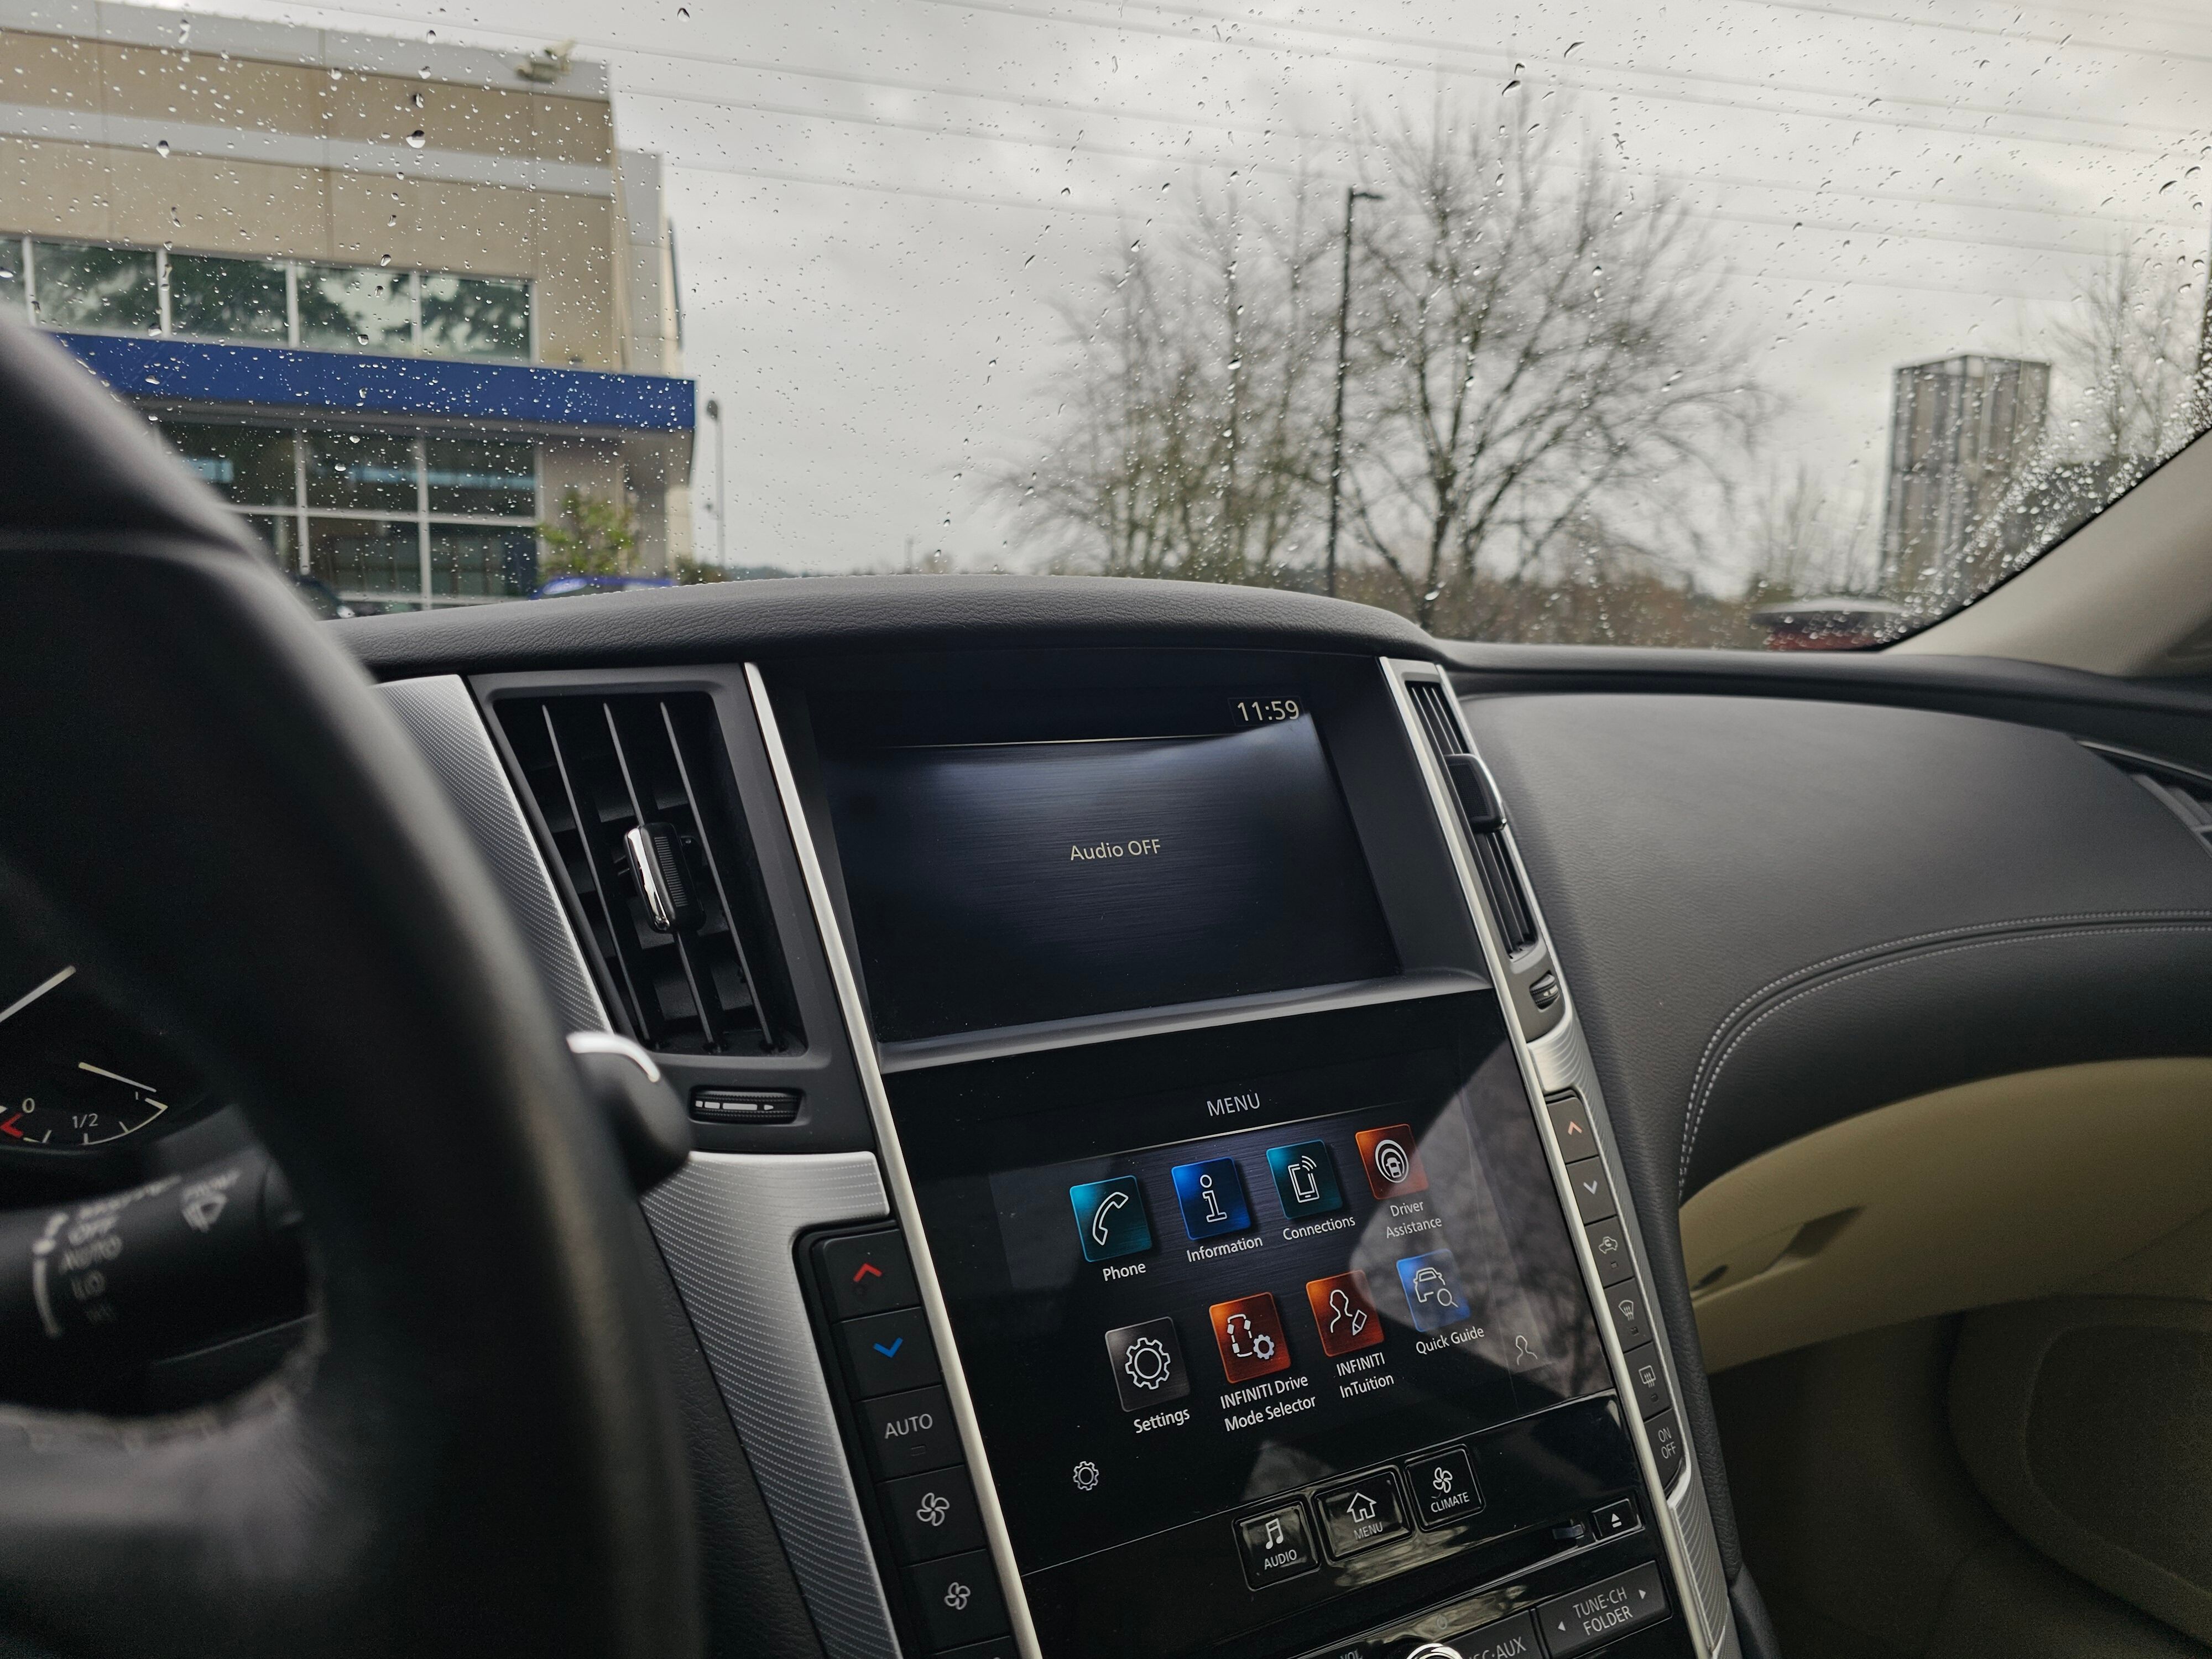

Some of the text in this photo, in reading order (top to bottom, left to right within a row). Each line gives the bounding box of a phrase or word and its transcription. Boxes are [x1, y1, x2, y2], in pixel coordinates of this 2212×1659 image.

[1236, 699, 1300, 722] 11:59
[1070, 838, 1161, 862] Audio OFF
[22, 1097, 35, 1114] 0
[1206, 1092, 1261, 1117] MENU
[72, 1113, 98, 1129] 1/2
[1390, 1201, 1425, 1218] Driver
[1282, 1215, 1356, 1241] Connections
[1385, 1215, 1443, 1239] Assistance
[1186, 1235, 1264, 1262] Information
[1102, 1260, 1147, 1282] Phone
[1415, 1326, 1485, 1355] Quick Guide
[1335, 1352, 1386, 1376] INFINITI
[1220, 1375, 1309, 1409] INFINITI Drive
[1338, 1371, 1395, 1399] InTuition
[1133, 1408, 1191, 1434] Settings
[1224, 1394, 1317, 1433] Mode Selector
[884, 1413, 933, 1439] AUTO
[1658, 1427, 1672, 1443] ON
[1661, 1441, 1677, 1459] OFF
[1431, 1491, 1470, 1513] CLIMATE
[1353, 1521, 1383, 1541] MENU
[1264, 1548, 1297, 1571] AUDIO
[1583, 1605, 1634, 1636] FOLDER
